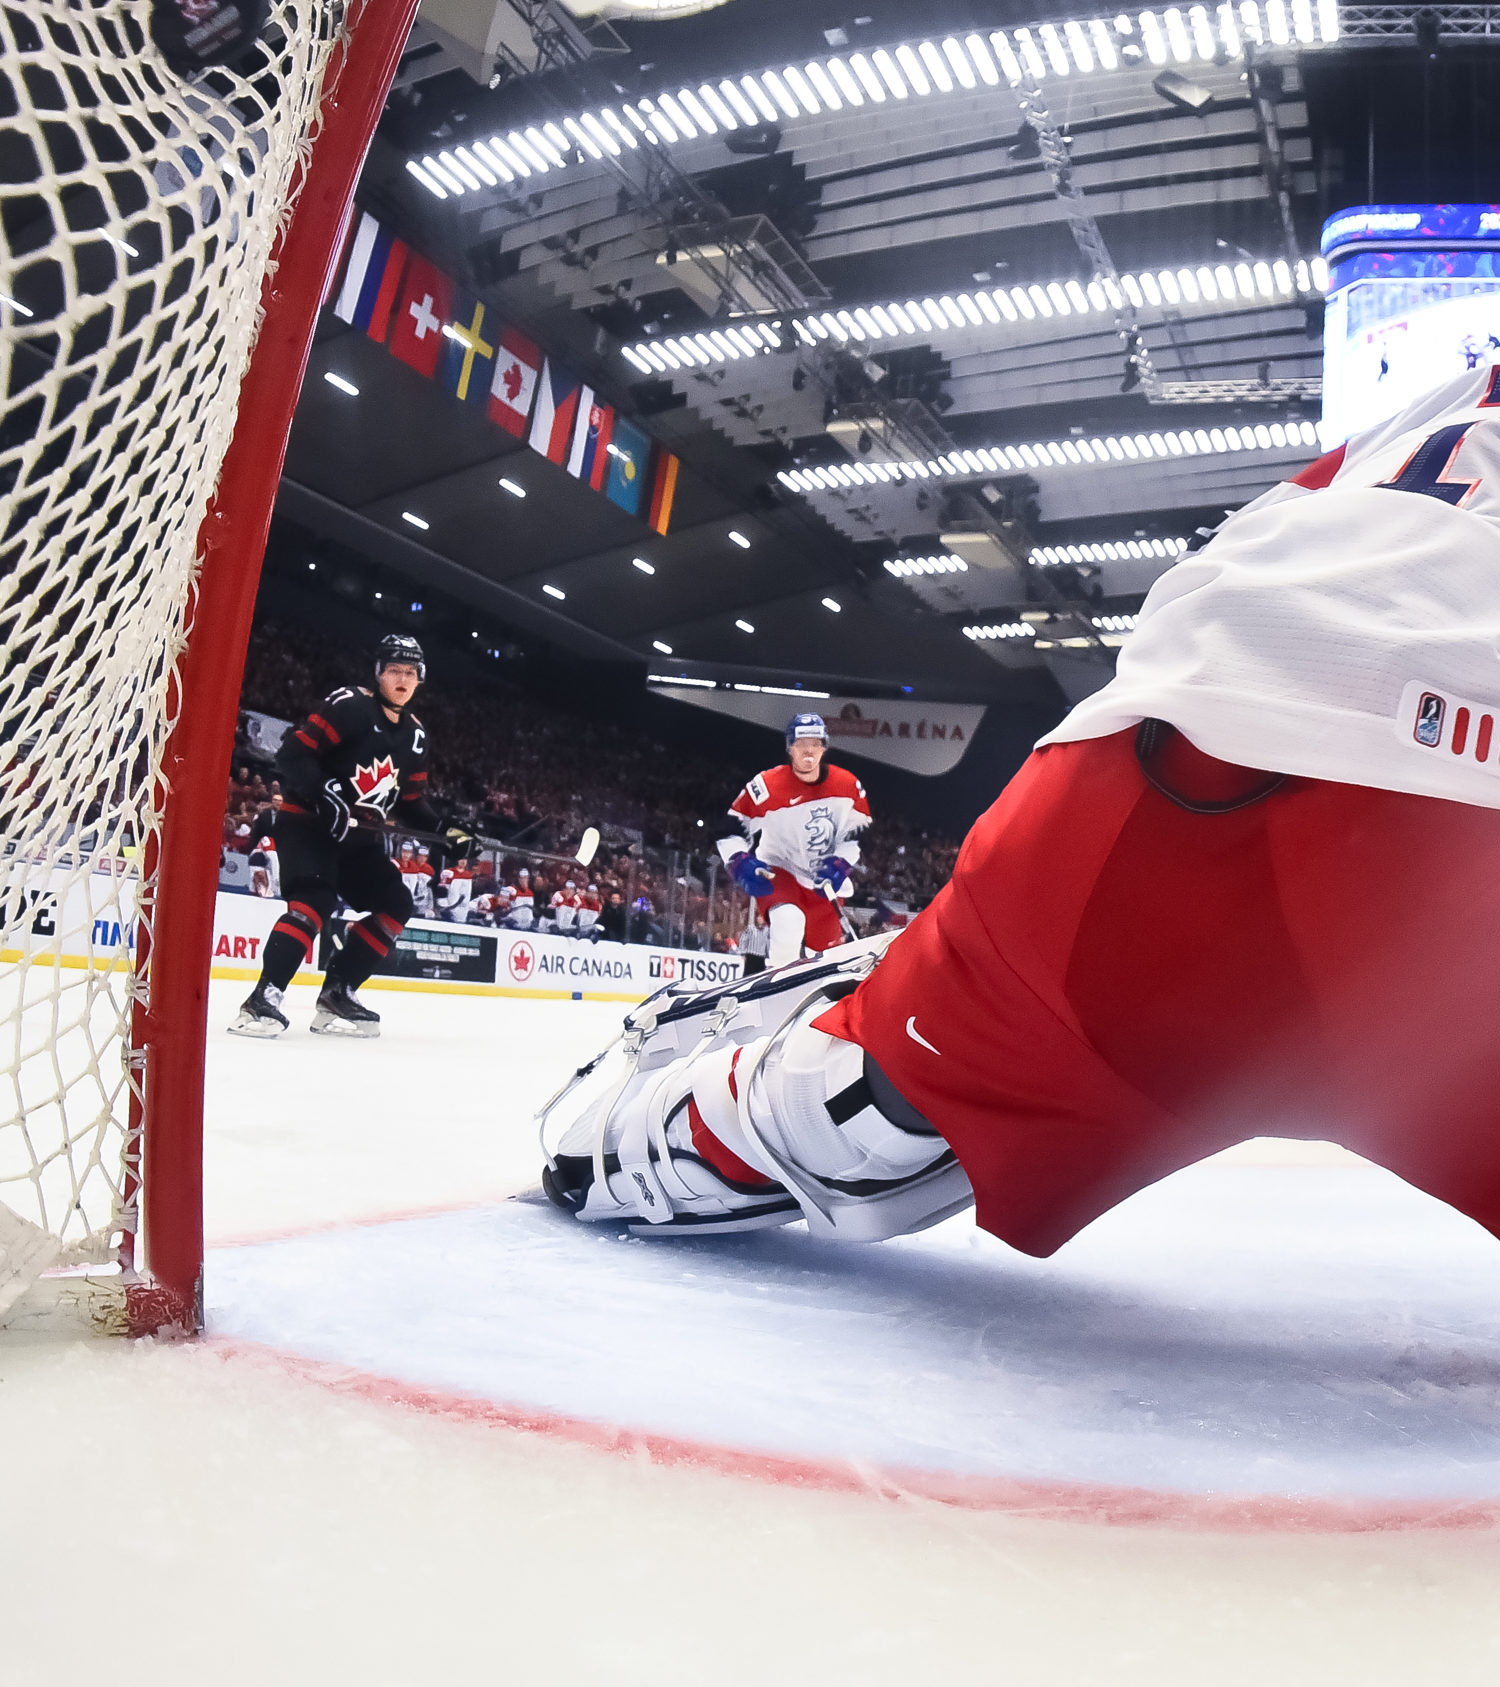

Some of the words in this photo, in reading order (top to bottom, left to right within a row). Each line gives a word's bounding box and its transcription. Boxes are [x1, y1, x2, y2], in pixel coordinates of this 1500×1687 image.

[411, 728, 426, 754] C
[538, 954, 566, 974] AIR
[569, 956, 633, 980] CANADA
[678, 957, 740, 982] TISSOT
